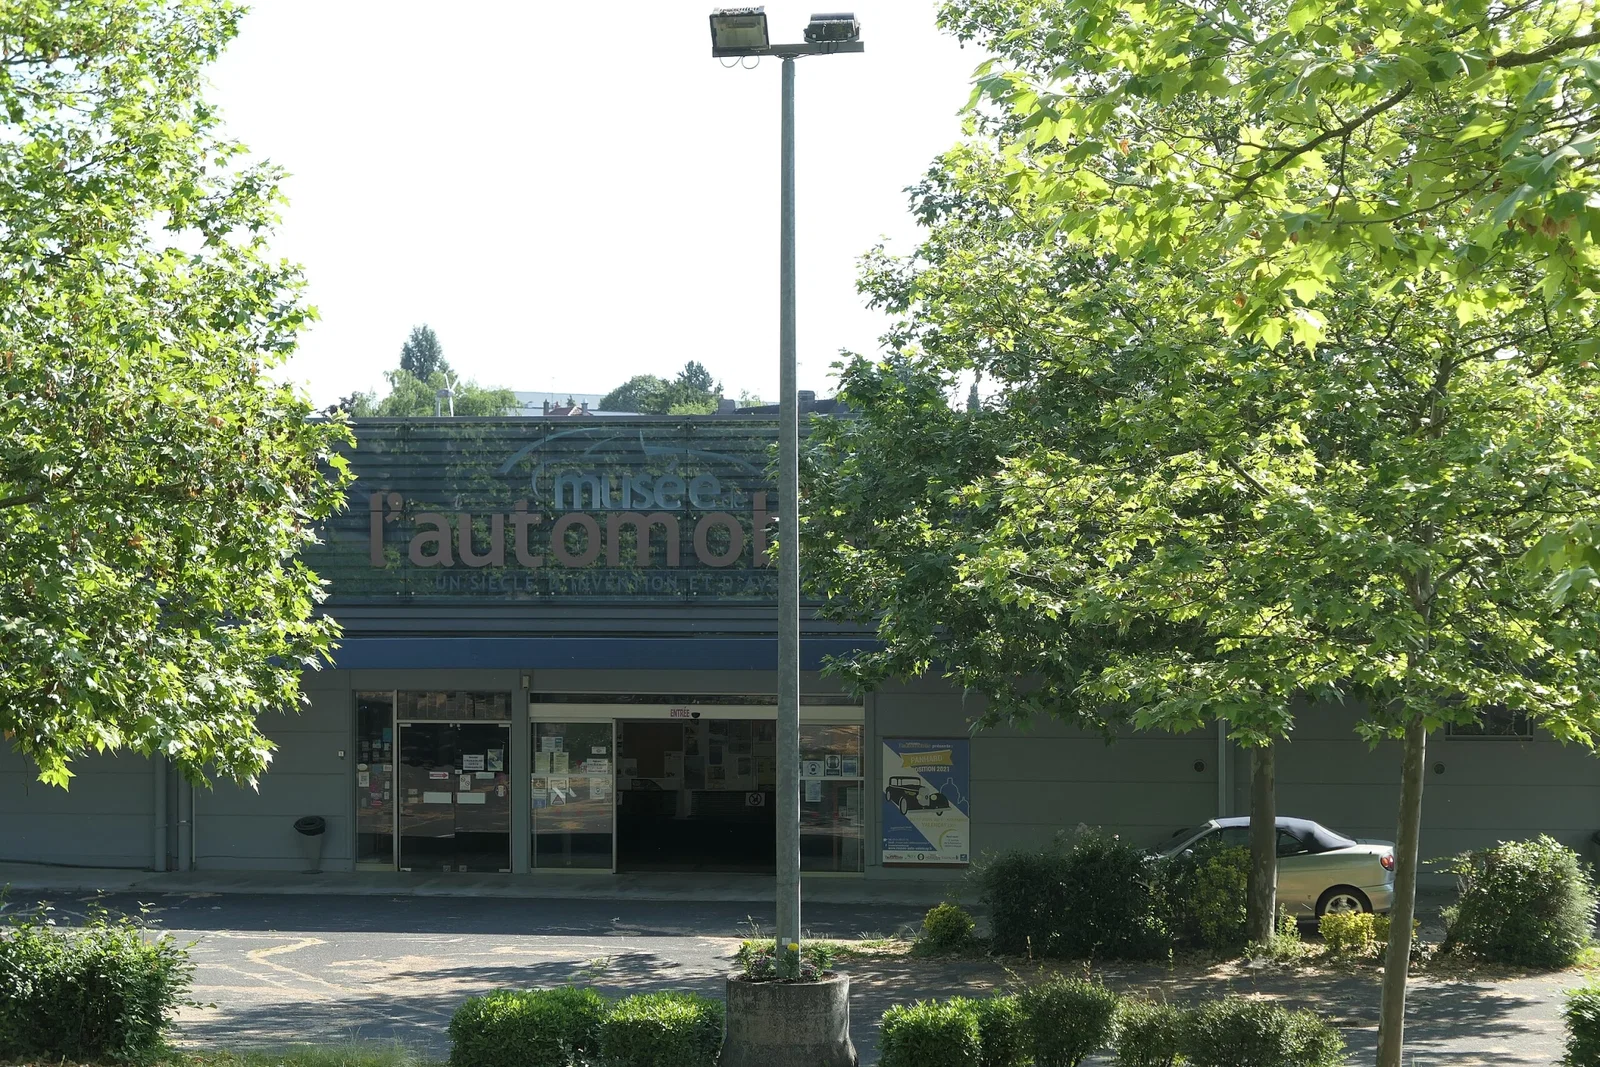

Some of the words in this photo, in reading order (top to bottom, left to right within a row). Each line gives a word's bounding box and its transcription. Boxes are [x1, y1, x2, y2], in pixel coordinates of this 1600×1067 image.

[554, 461, 720, 509] musée
[435, 575, 461, 591] UN
[689, 575, 711, 591] ET
[670, 706, 690, 718] ENTRÉE
[910, 754, 943, 764] PANHARD
